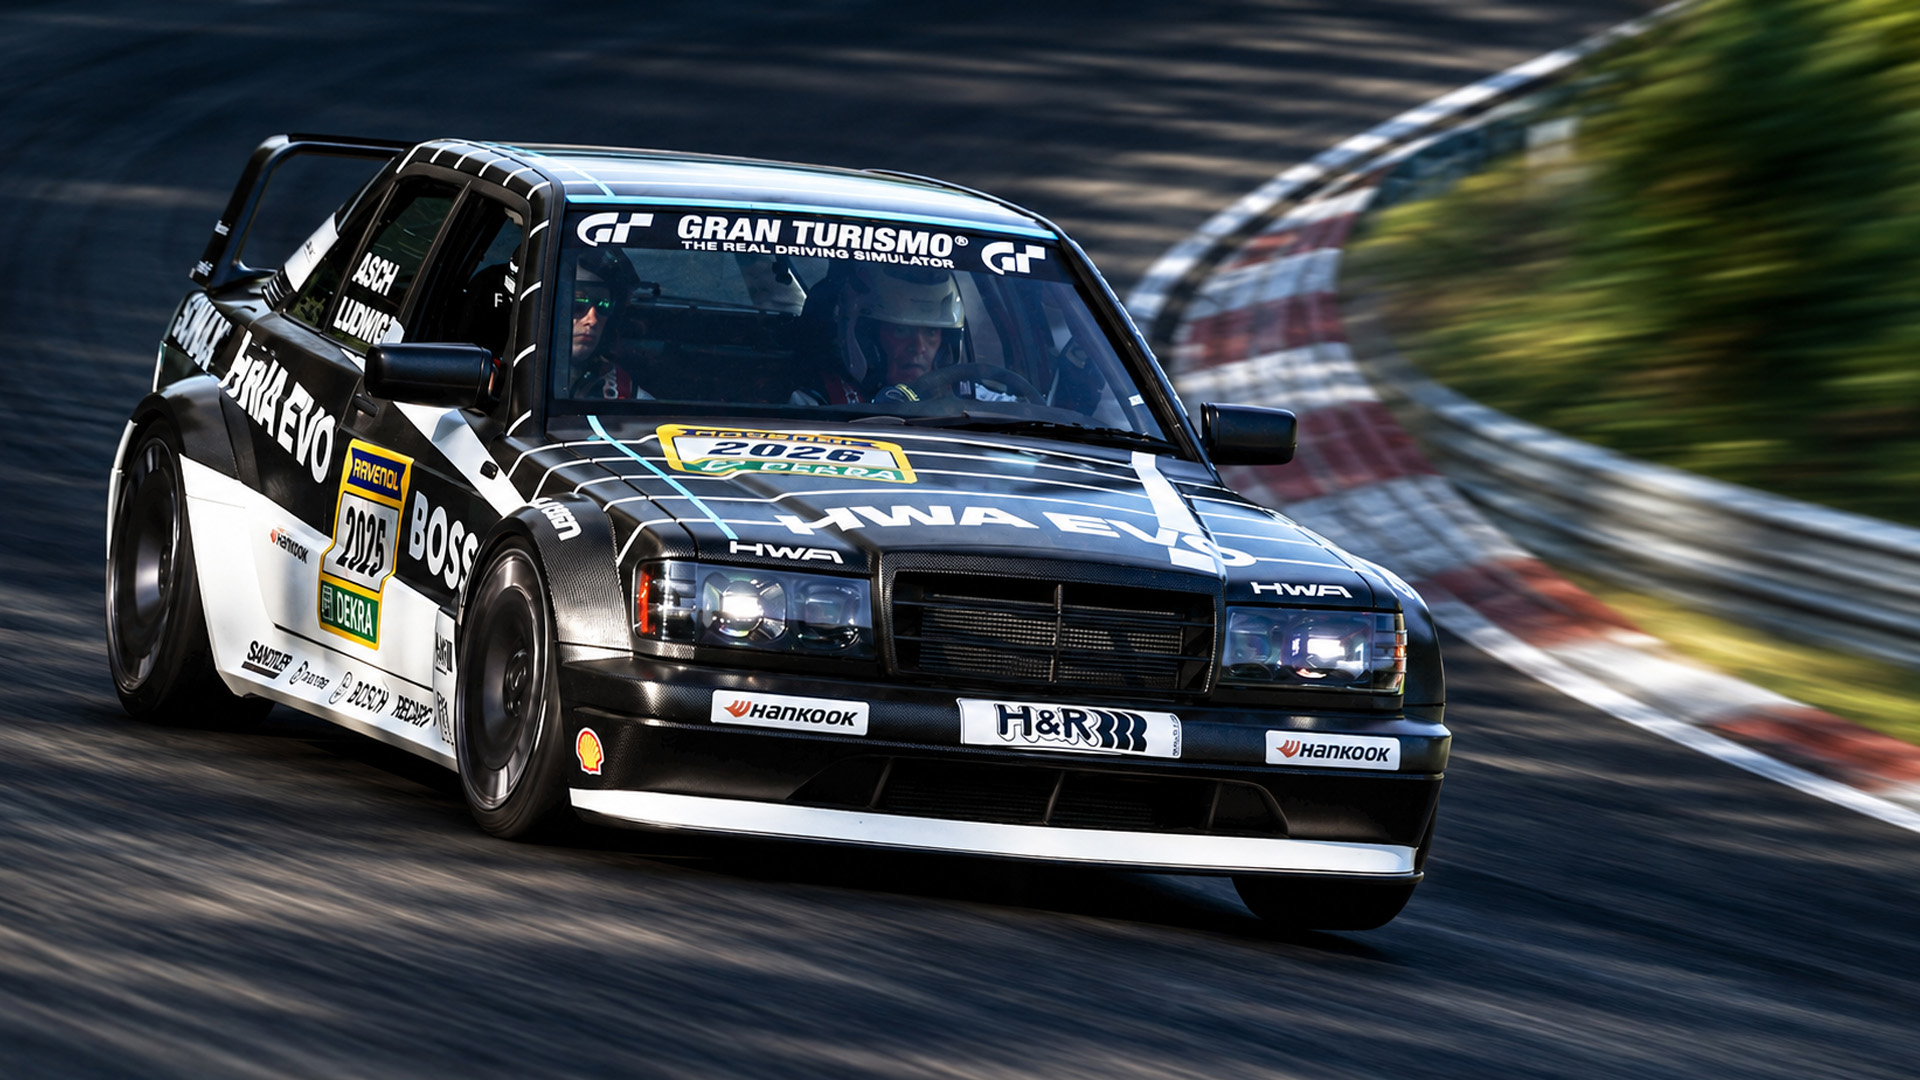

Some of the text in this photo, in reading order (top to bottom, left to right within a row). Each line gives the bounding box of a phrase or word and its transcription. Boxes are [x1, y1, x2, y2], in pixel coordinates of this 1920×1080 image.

[677, 214, 782, 244] GRAN
[681, 240, 955, 269] THE REAL DRIVING SIMULATOR
[351, 252, 400, 297] ASCH
[276, 381, 336, 484] EVO
[707, 441, 865, 463] 2026
[352, 458, 399, 491] RAVENOL
[775, 505, 1040, 536] HWA
[335, 505, 387, 577] 2025
[729, 540, 844, 565] HWA
[1251, 581, 1353, 598] HWA
[336, 590, 374, 637] DEKRA
[346, 680, 389, 714] BOSCH
[994, 703, 1098, 747] H&R
